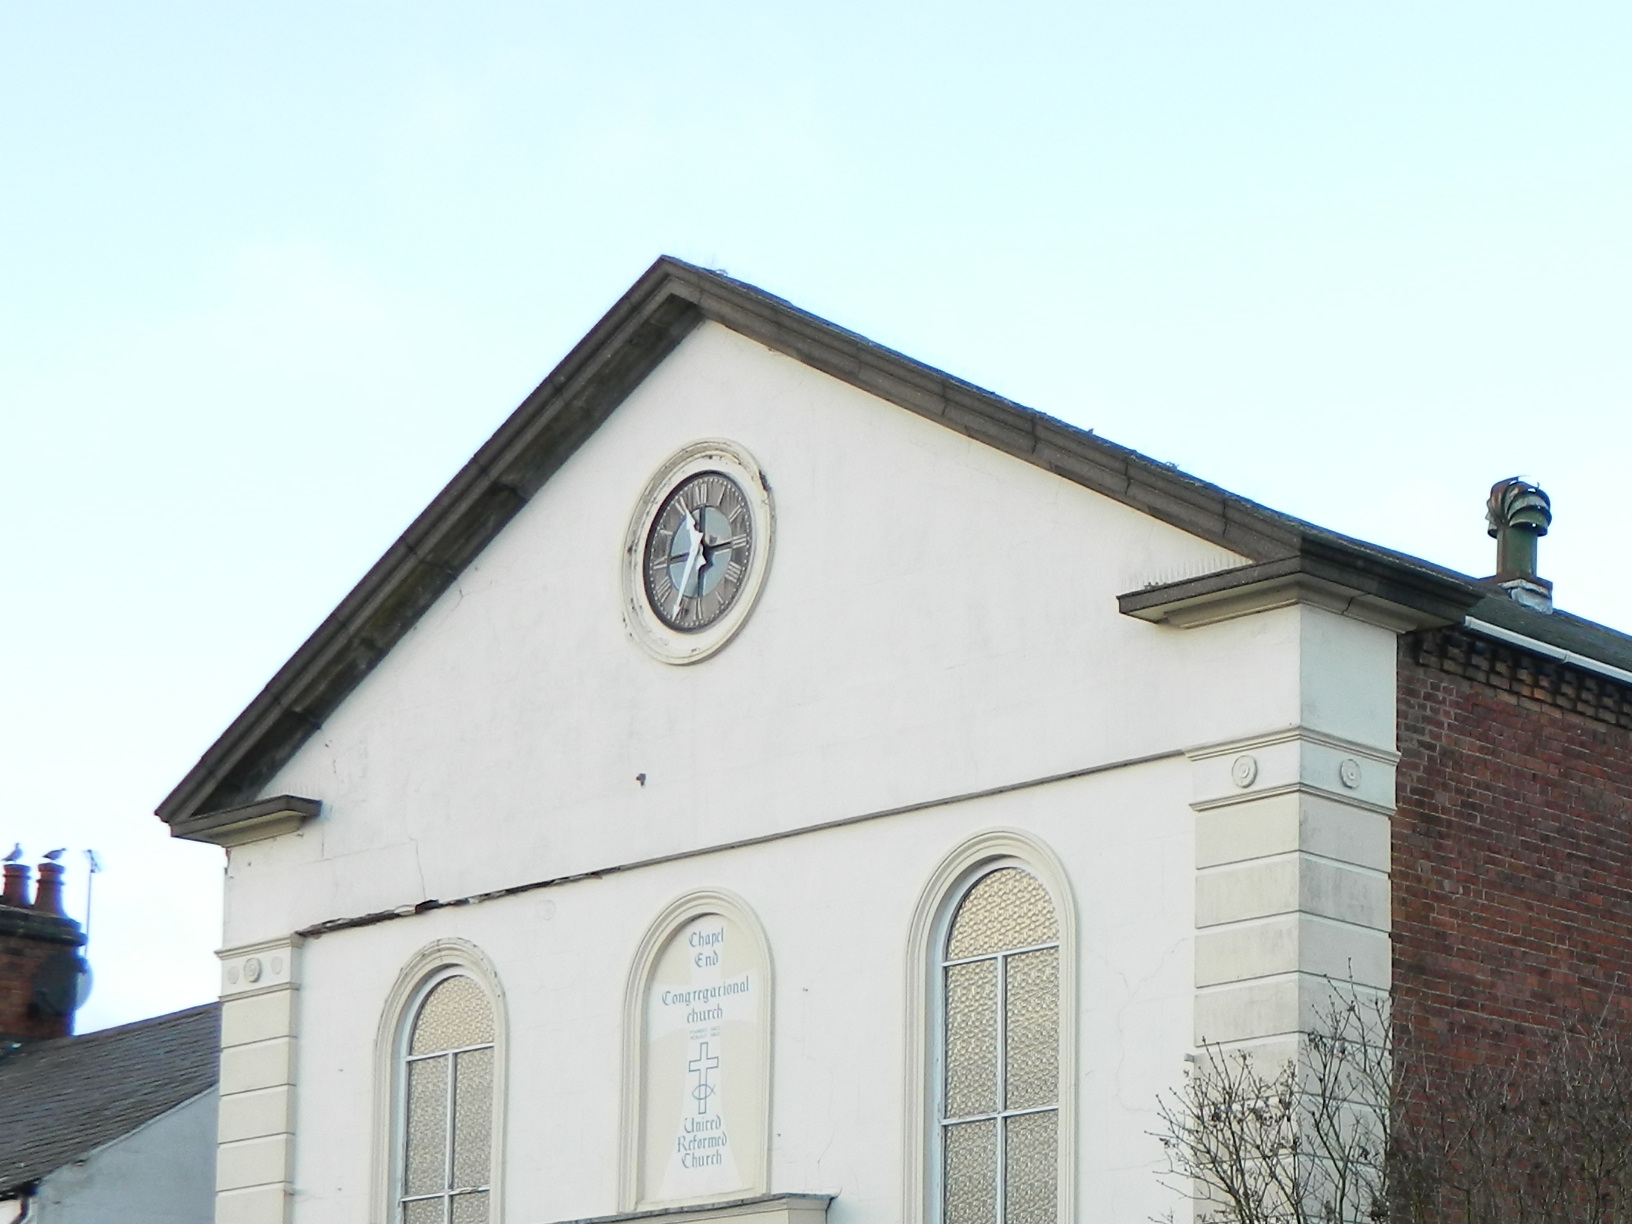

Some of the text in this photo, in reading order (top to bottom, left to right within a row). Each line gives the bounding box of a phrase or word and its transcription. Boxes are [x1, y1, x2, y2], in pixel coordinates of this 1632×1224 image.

[689, 926, 724, 948] Chapel
[694, 949, 719, 968] End
[661, 975, 749, 1007] Congregational
[686, 1003, 723, 1023] church
[684, 1114, 721, 1133] United
[677, 1131, 727, 1153] Reformed
[681, 1149, 722, 1169] Church
